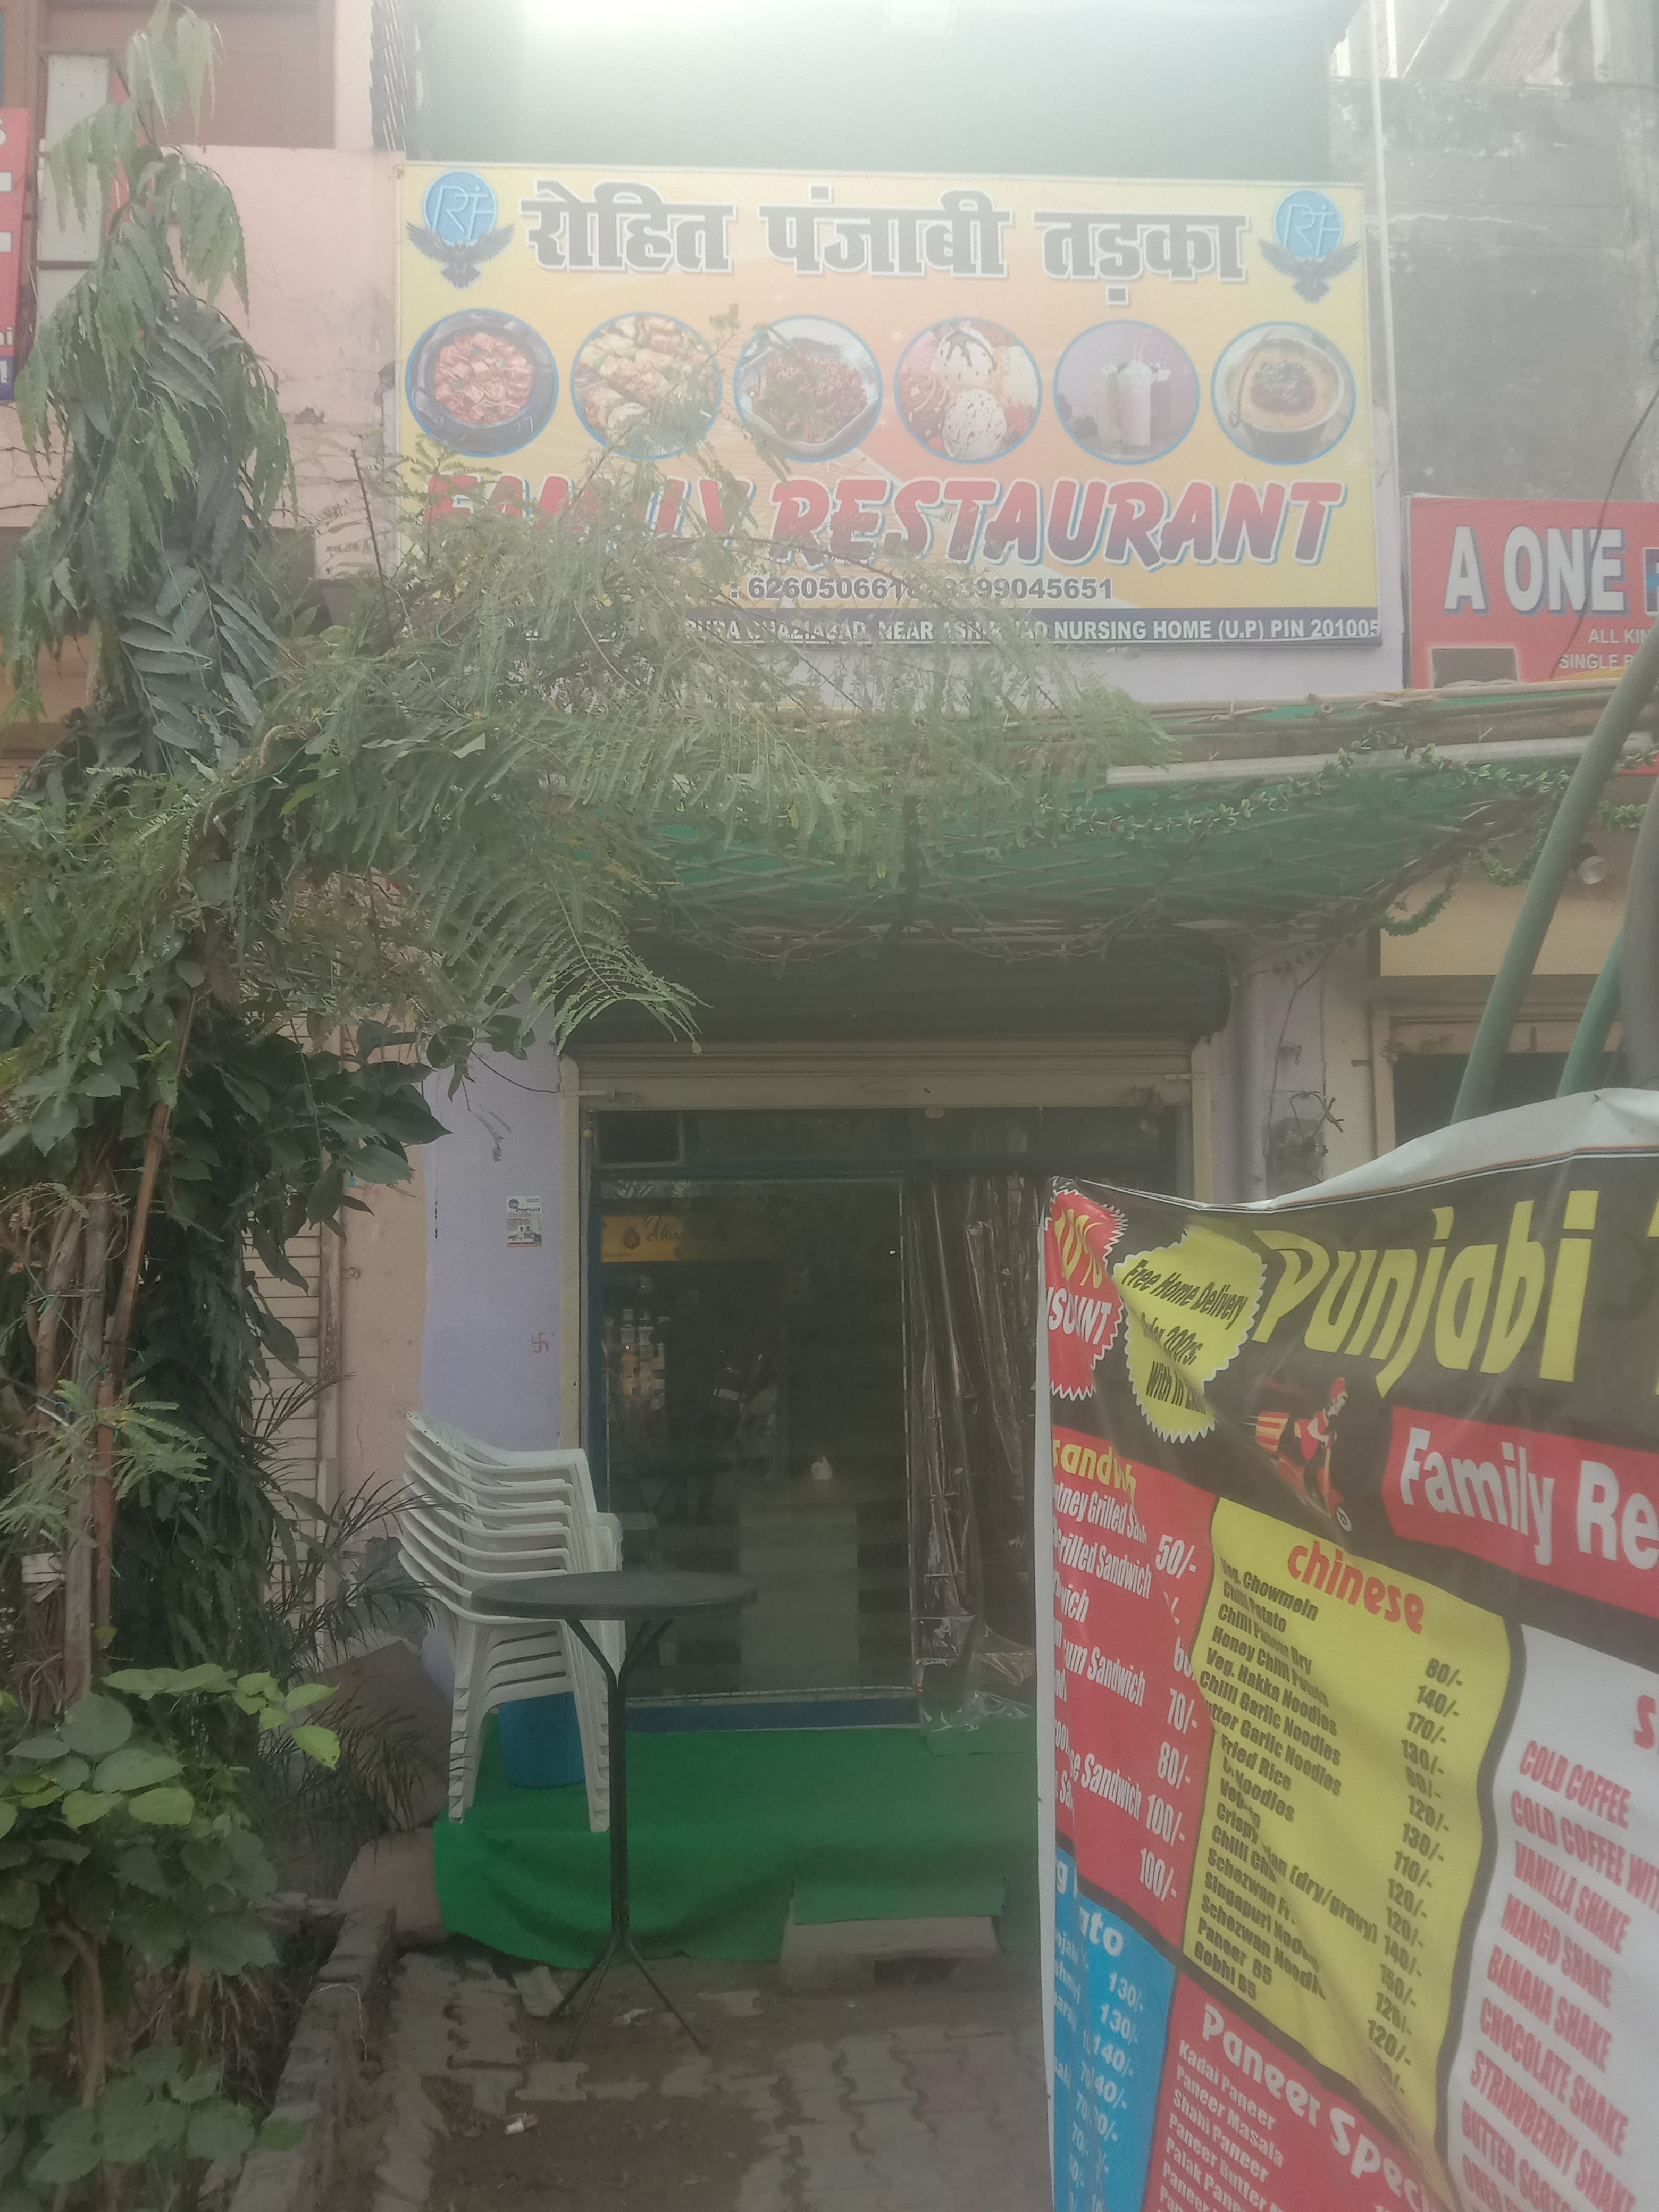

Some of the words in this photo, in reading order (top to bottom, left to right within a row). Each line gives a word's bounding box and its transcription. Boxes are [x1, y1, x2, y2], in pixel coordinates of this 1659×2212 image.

[520, 179, 737, 272] रोहित
[759, 185, 1012, 279] पंजाबी
[1033, 209, 1250, 306] तड़का
[769, 476, 1347, 571] RESTAURANT
[1443, 525, 1489, 614] A
[1503, 525, 1628, 615] ONE
[878, 621, 934, 640] NEAR
[1054, 620, 1146, 640] NURSING
[1153, 620, 1212, 640] HOME
[1218, 619, 1264, 641] (U.P)
[1271, 619, 1304, 639] PIN
[1310, 619, 1379, 639] 201005
[1559, 653, 1620, 669] SINGLE
[1587, 628, 1620, 644] ALL
[1122, 1259, 1162, 1292] Free
[1149, 1272, 1201, 1306] Home
[1189, 1281, 1249, 1330] Delivery
[1251, 1188, 1600, 1399] Punjabi
[1400, 1426, 1555, 1567] Family
[1087, 1490, 1128, 1536] Grilled
[1155, 1534, 1197, 1580] 50/-
[1096, 1544, 1152, 1599] Sandwich
[1287, 1540, 1423, 1635] chinese
[1087, 1646, 1146, 1707] Sandwich
[1237, 1664, 1281, 1703] Hakka
[1281, 1687, 1338, 1737] Noodles
[1416, 1685, 1460, 1719] 140/-
[1425, 1657, 1463, 1688] 80/-
[1239, 1691, 1283, 1730] Garlic
[1283, 1715, 1342, 1766] Noodles
[1409, 1794, 1451, 1832] 120/-
[1400, 1739, 1445, 1775] 130/-
[1406, 1711, 1447, 1745] 170/-
[1080, 1753, 1143, 1821] Sandwich
[1157, 1741, 1191, 1790] 80/-
[1239, 1719, 1284, 1758] Garlic
[1284, 1744, 1342, 1797] Noodles
[1402, 1822, 1444, 1862] 130/-
[1519, 1740, 1569, 1793] COLD
[1565, 1764, 1631, 1830] COFFEE
[1146, 1794, 1186, 1847] 100/-
[1258, 1757, 1292, 1791] Rice
[1393, 1850, 1434, 1889] 110/-
[1511, 1790, 1559, 1847] COLD
[1561, 1816, 1627, 1887] COFFEE
[1139, 1848, 1177, 1903] 100/-
[1387, 1878, 1428, 1919] 120/-
[1386, 1907, 1424, 1948] 120/-
[1500, 1893, 1561, 1965] MANGO
[1574, 1885, 1632, 1956] SHAKE
[1486, 1944, 1554, 2026] BANANA
[1202, 2002, 1321, 2128] Paneer
[1368, 2019, 1412, 2066] 120/-
[1480, 1997, 1573, 2105] CHOCOLATE
[1176, 2065, 1226, 2119] Paneer
[1226, 2109, 1284, 2168] Masala
[1178, 2040, 1220, 2086] Kadai
[1221, 2073, 1276, 2132] Paneer
[1165, 2136, 1202, 2185] Palak
[1169, 2113, 1218, 2168] Paneer
[1172, 2089, 1211, 2136] Shahi
[1212, 2126, 1270, 2183] Paneer
